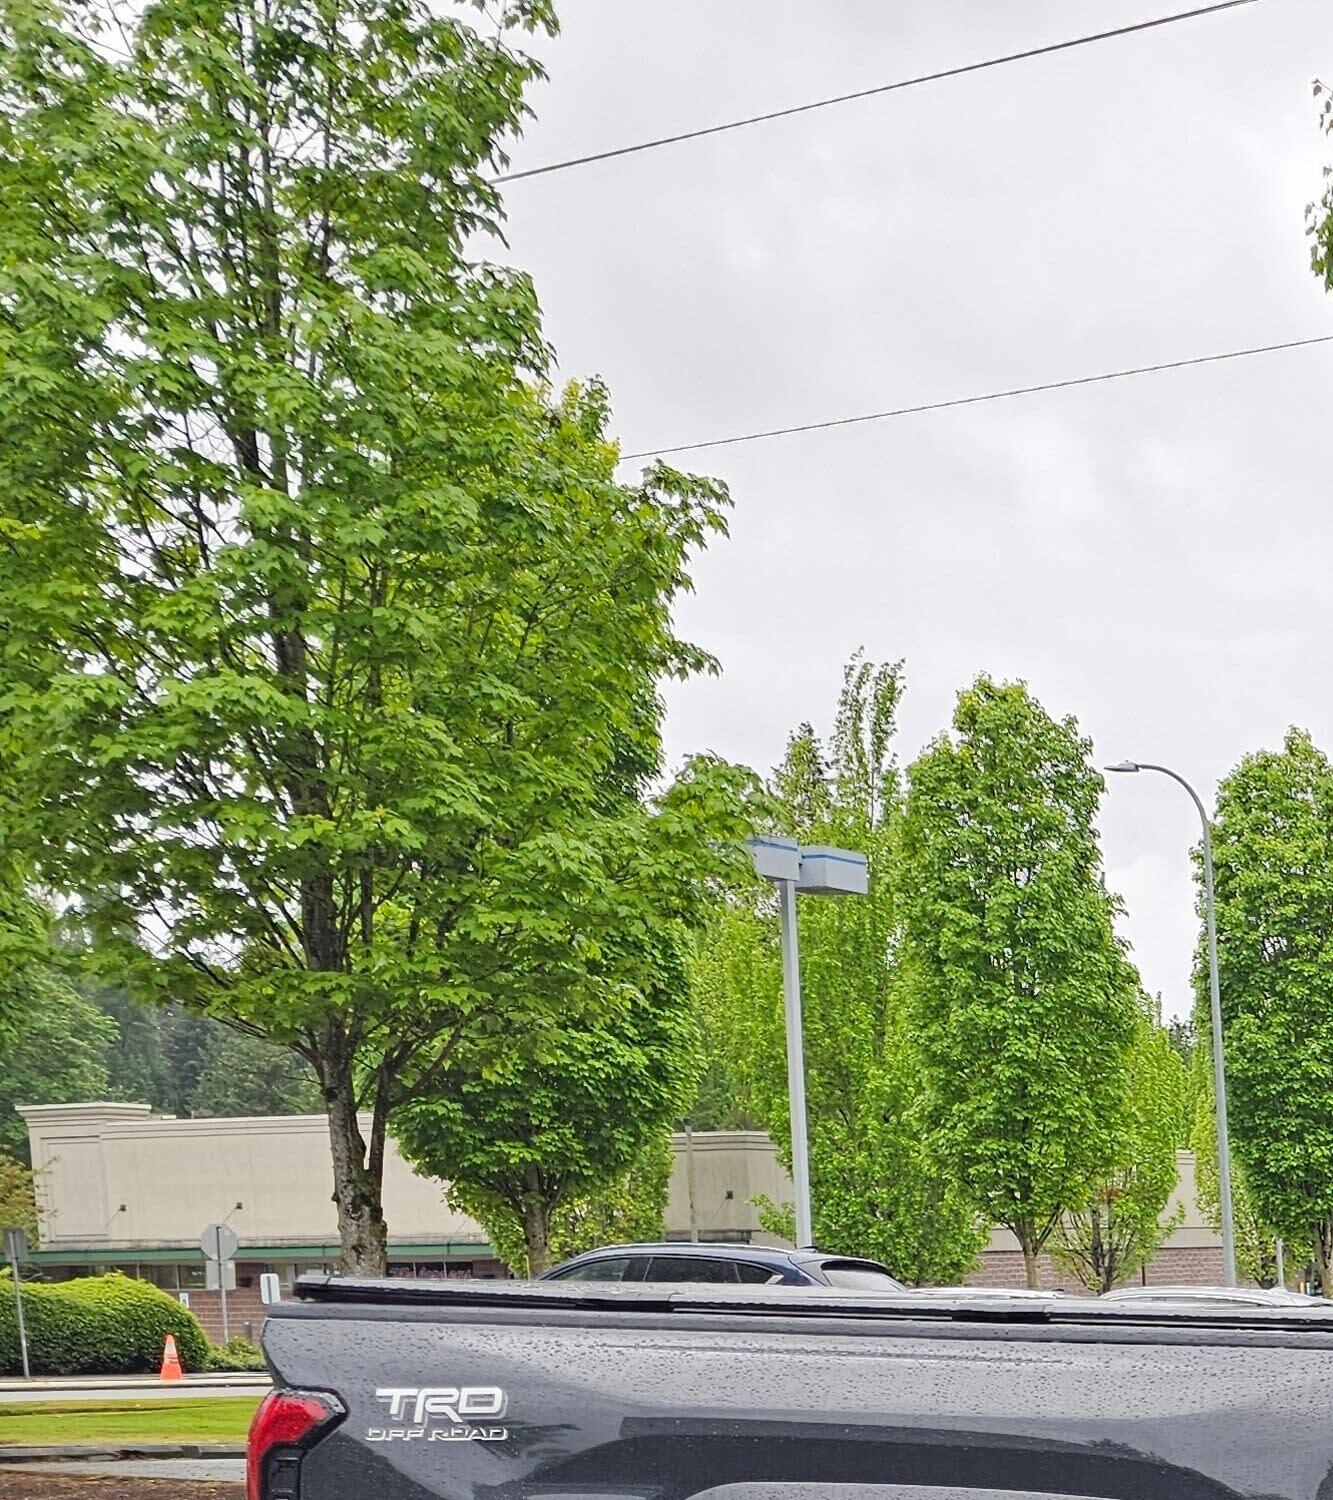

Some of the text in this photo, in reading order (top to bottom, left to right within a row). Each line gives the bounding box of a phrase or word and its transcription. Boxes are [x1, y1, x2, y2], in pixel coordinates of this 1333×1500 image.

[375, 1386, 509, 1426] TRD
[365, 1426, 508, 1442] OFF ROAD
